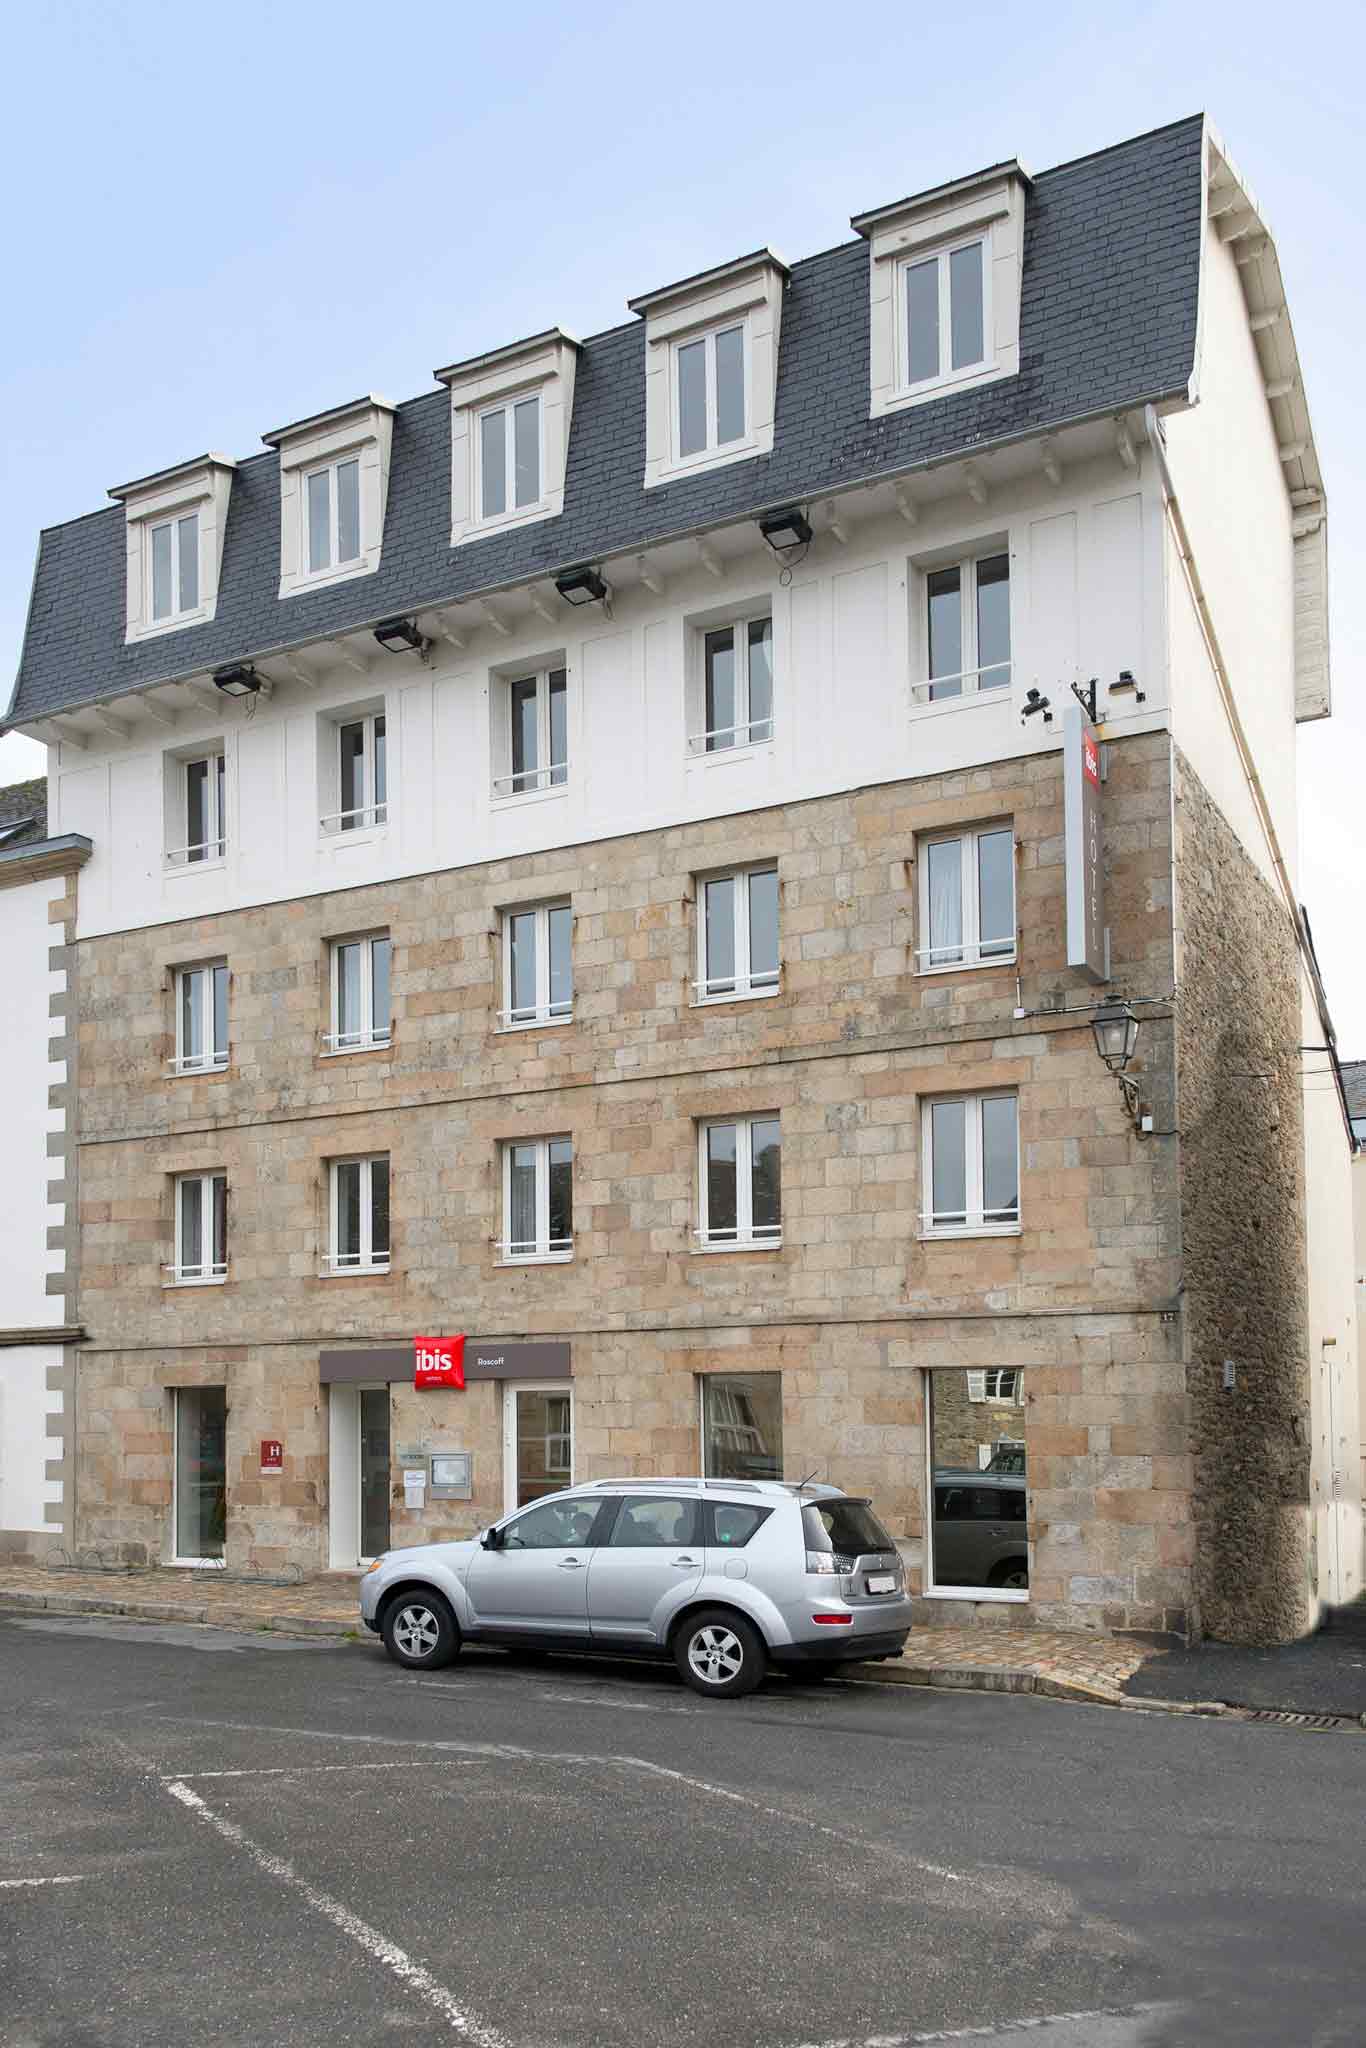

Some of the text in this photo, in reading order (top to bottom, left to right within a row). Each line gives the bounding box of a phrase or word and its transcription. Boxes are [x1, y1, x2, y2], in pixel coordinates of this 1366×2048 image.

[1086, 747, 1097, 776] ibis
[1089, 808, 1098, 951] HOTEL
[416, 1349, 452, 1371] ibis
[478, 1357, 504, 1366] Roscoff
[271, 1446, 280, 1456] H
